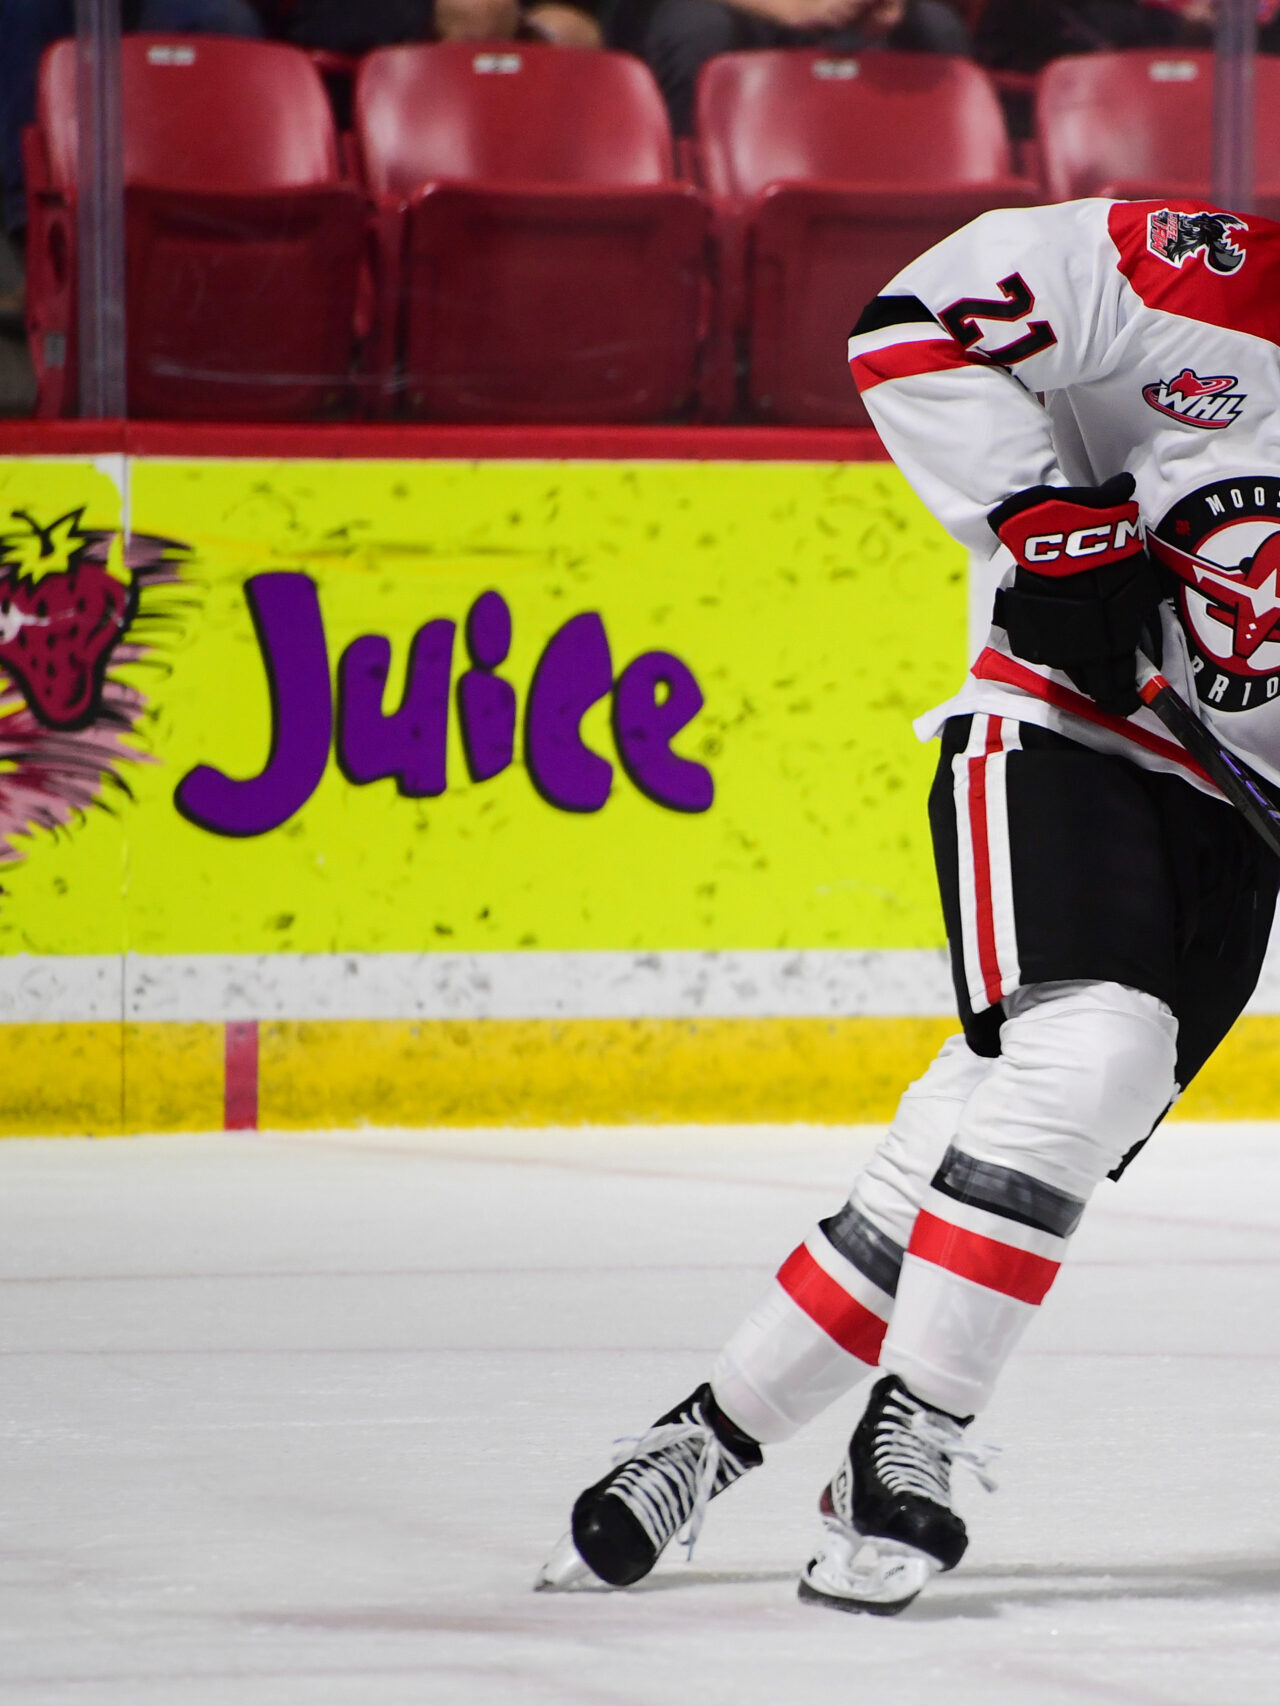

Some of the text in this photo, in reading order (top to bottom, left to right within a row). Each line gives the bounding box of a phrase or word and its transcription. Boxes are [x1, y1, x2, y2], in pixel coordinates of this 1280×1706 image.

[936, 271, 1058, 367] 21
[1156, 380, 1247, 421] WHL
[1023, 514, 1145, 563] CCM
[174, 570, 715, 839] Juice
